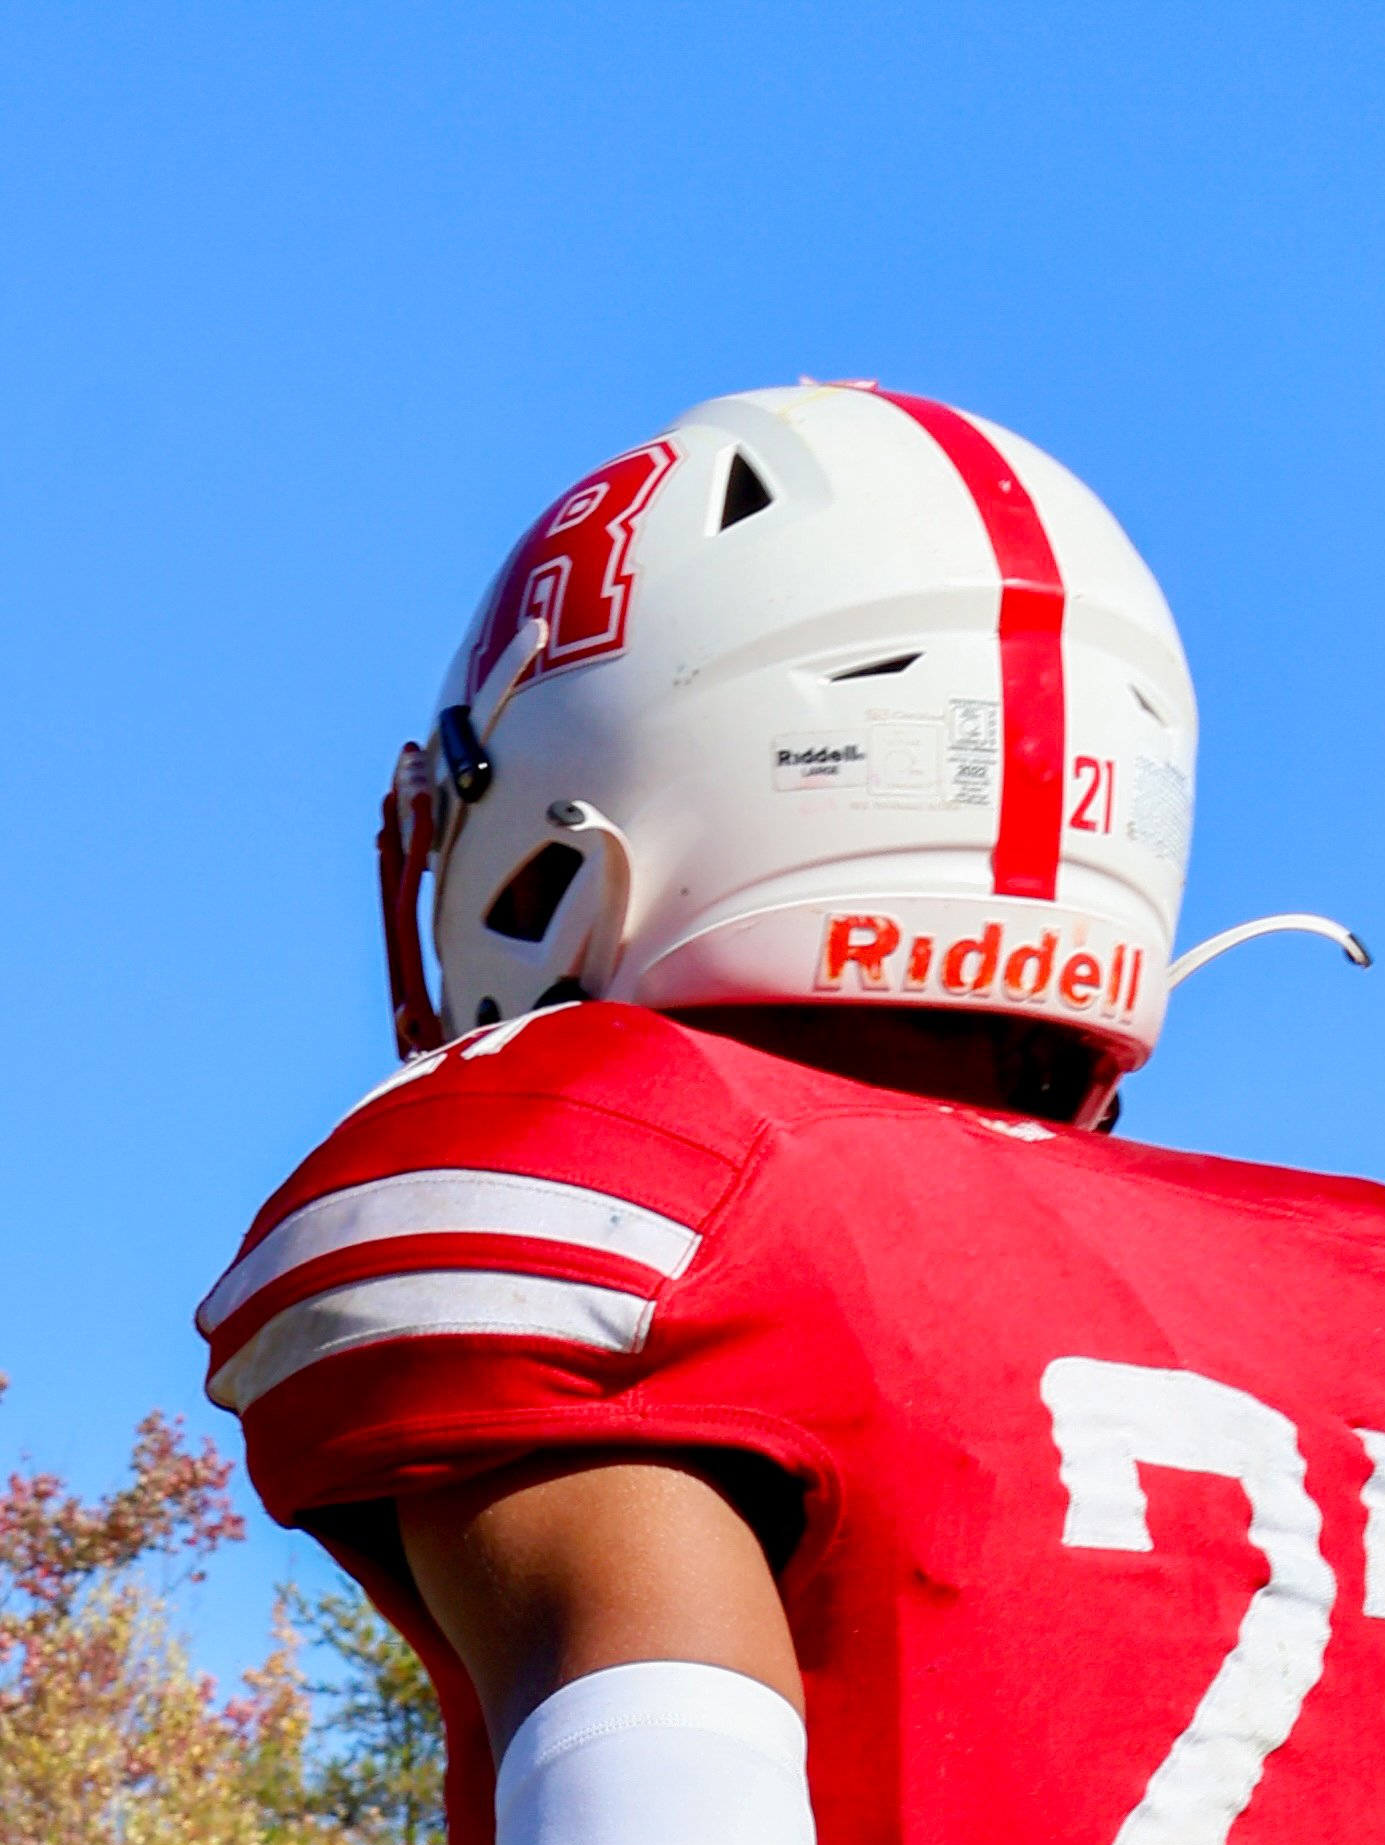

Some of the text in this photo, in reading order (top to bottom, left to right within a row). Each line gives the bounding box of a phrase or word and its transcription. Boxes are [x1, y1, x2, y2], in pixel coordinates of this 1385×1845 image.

[463, 440, 680, 706] R
[777, 745, 865, 766] Riddell
[1069, 755, 1114, 834] 21
[814, 913, 1144, 1023] Riddell
